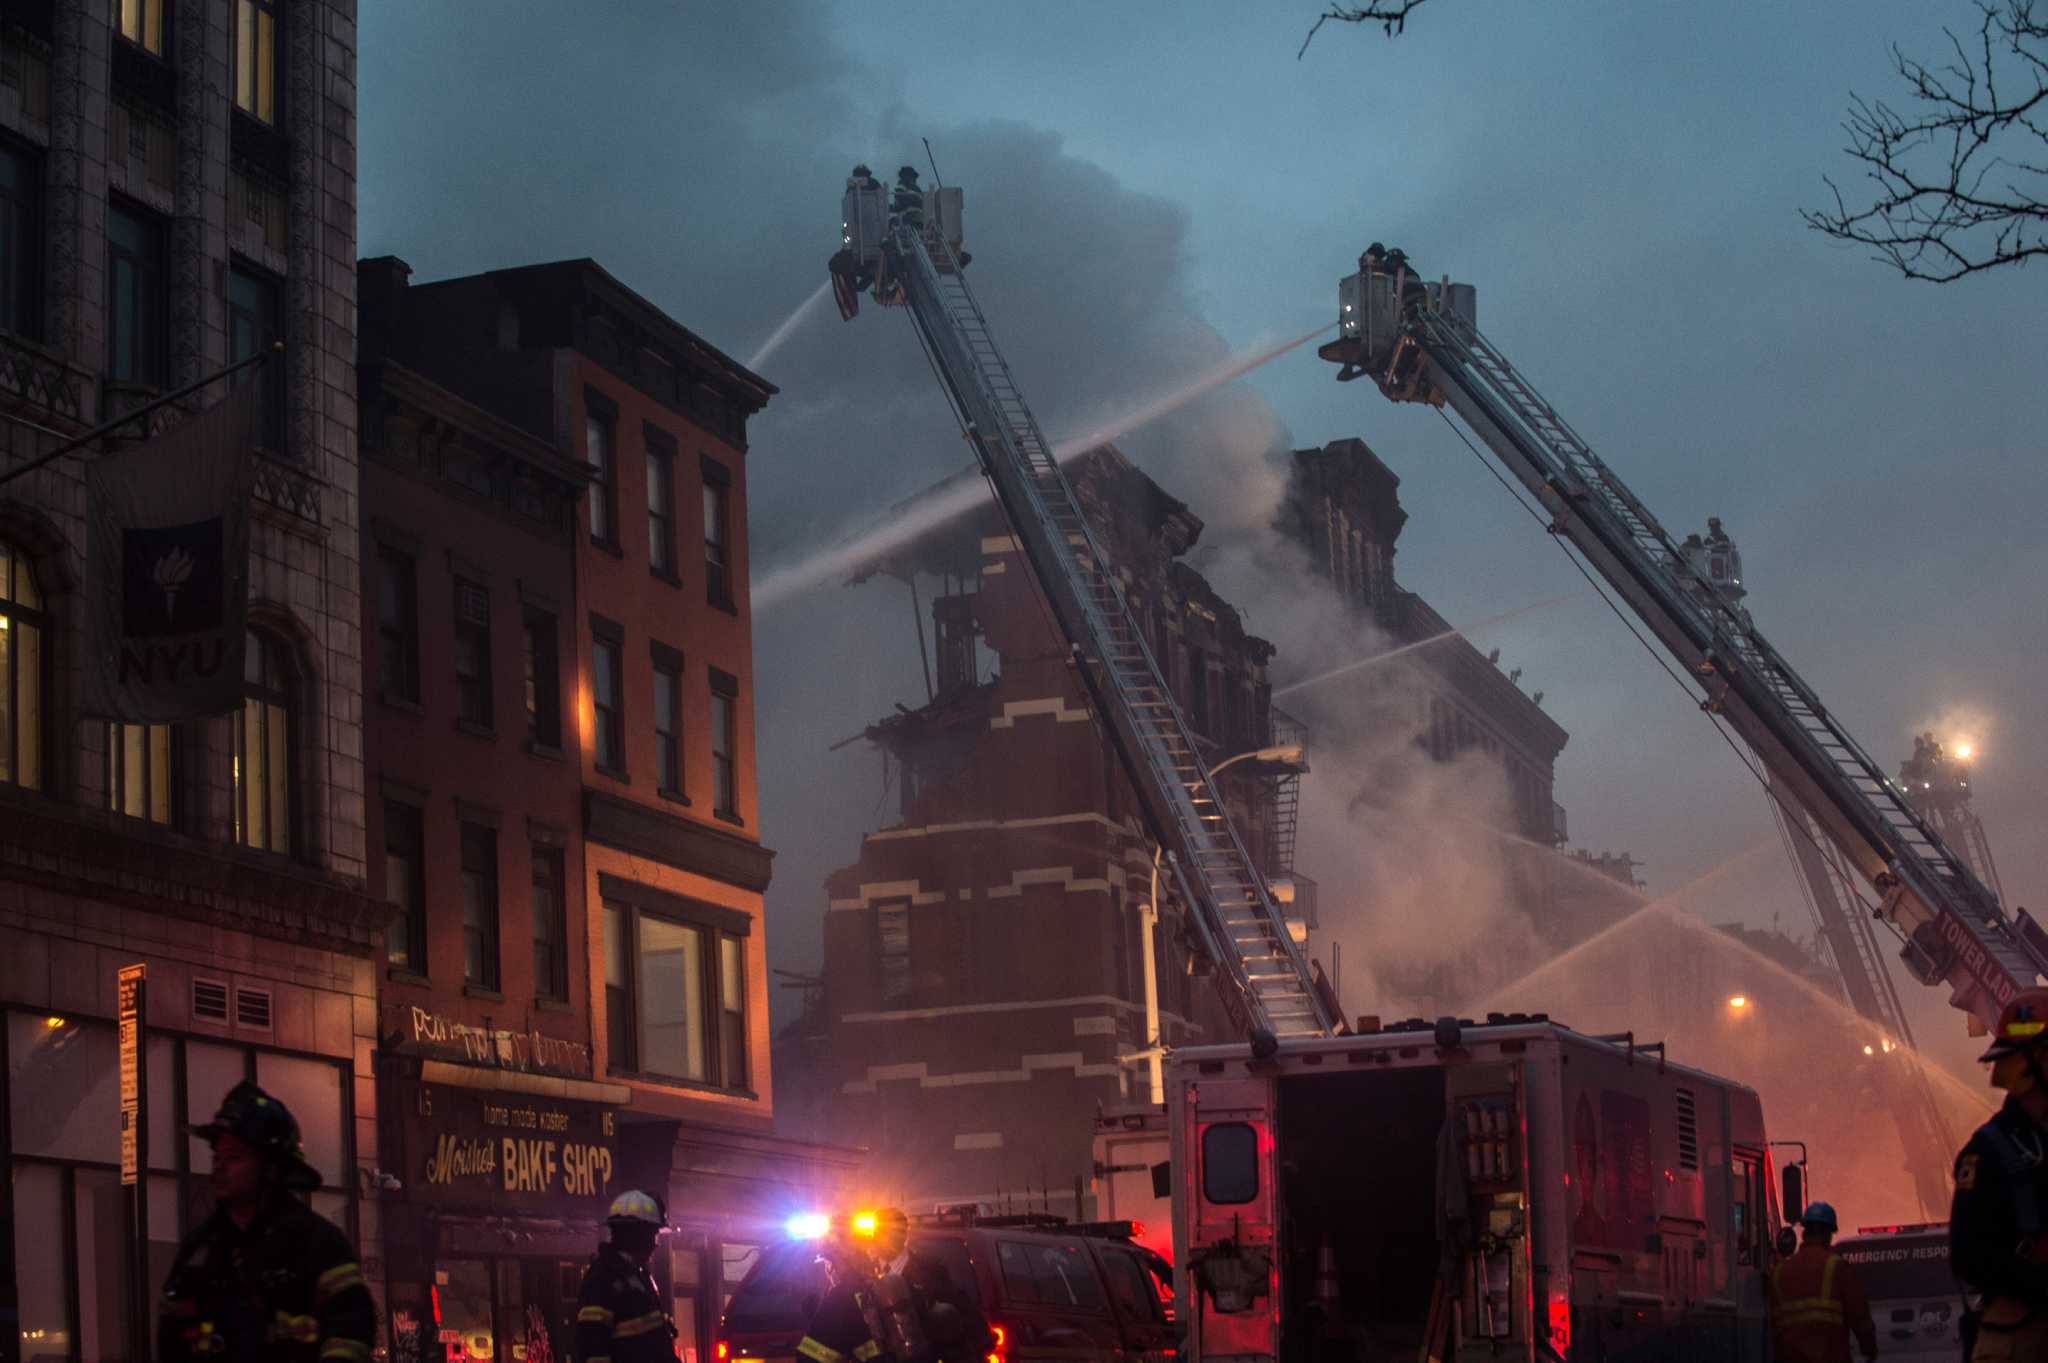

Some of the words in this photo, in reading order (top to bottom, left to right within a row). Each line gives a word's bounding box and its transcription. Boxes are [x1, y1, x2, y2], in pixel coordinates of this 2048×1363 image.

[118, 638, 224, 685] NYU
[1941, 911, 1987, 976] TOWER
[483, 1100, 509, 1126] home
[512, 1104, 537, 1129] made
[539, 1106, 569, 1132] kosher
[602, 1112, 615, 1137] 115
[502, 1136, 557, 1192] BAKE
[563, 1143, 612, 1196] SHOP
